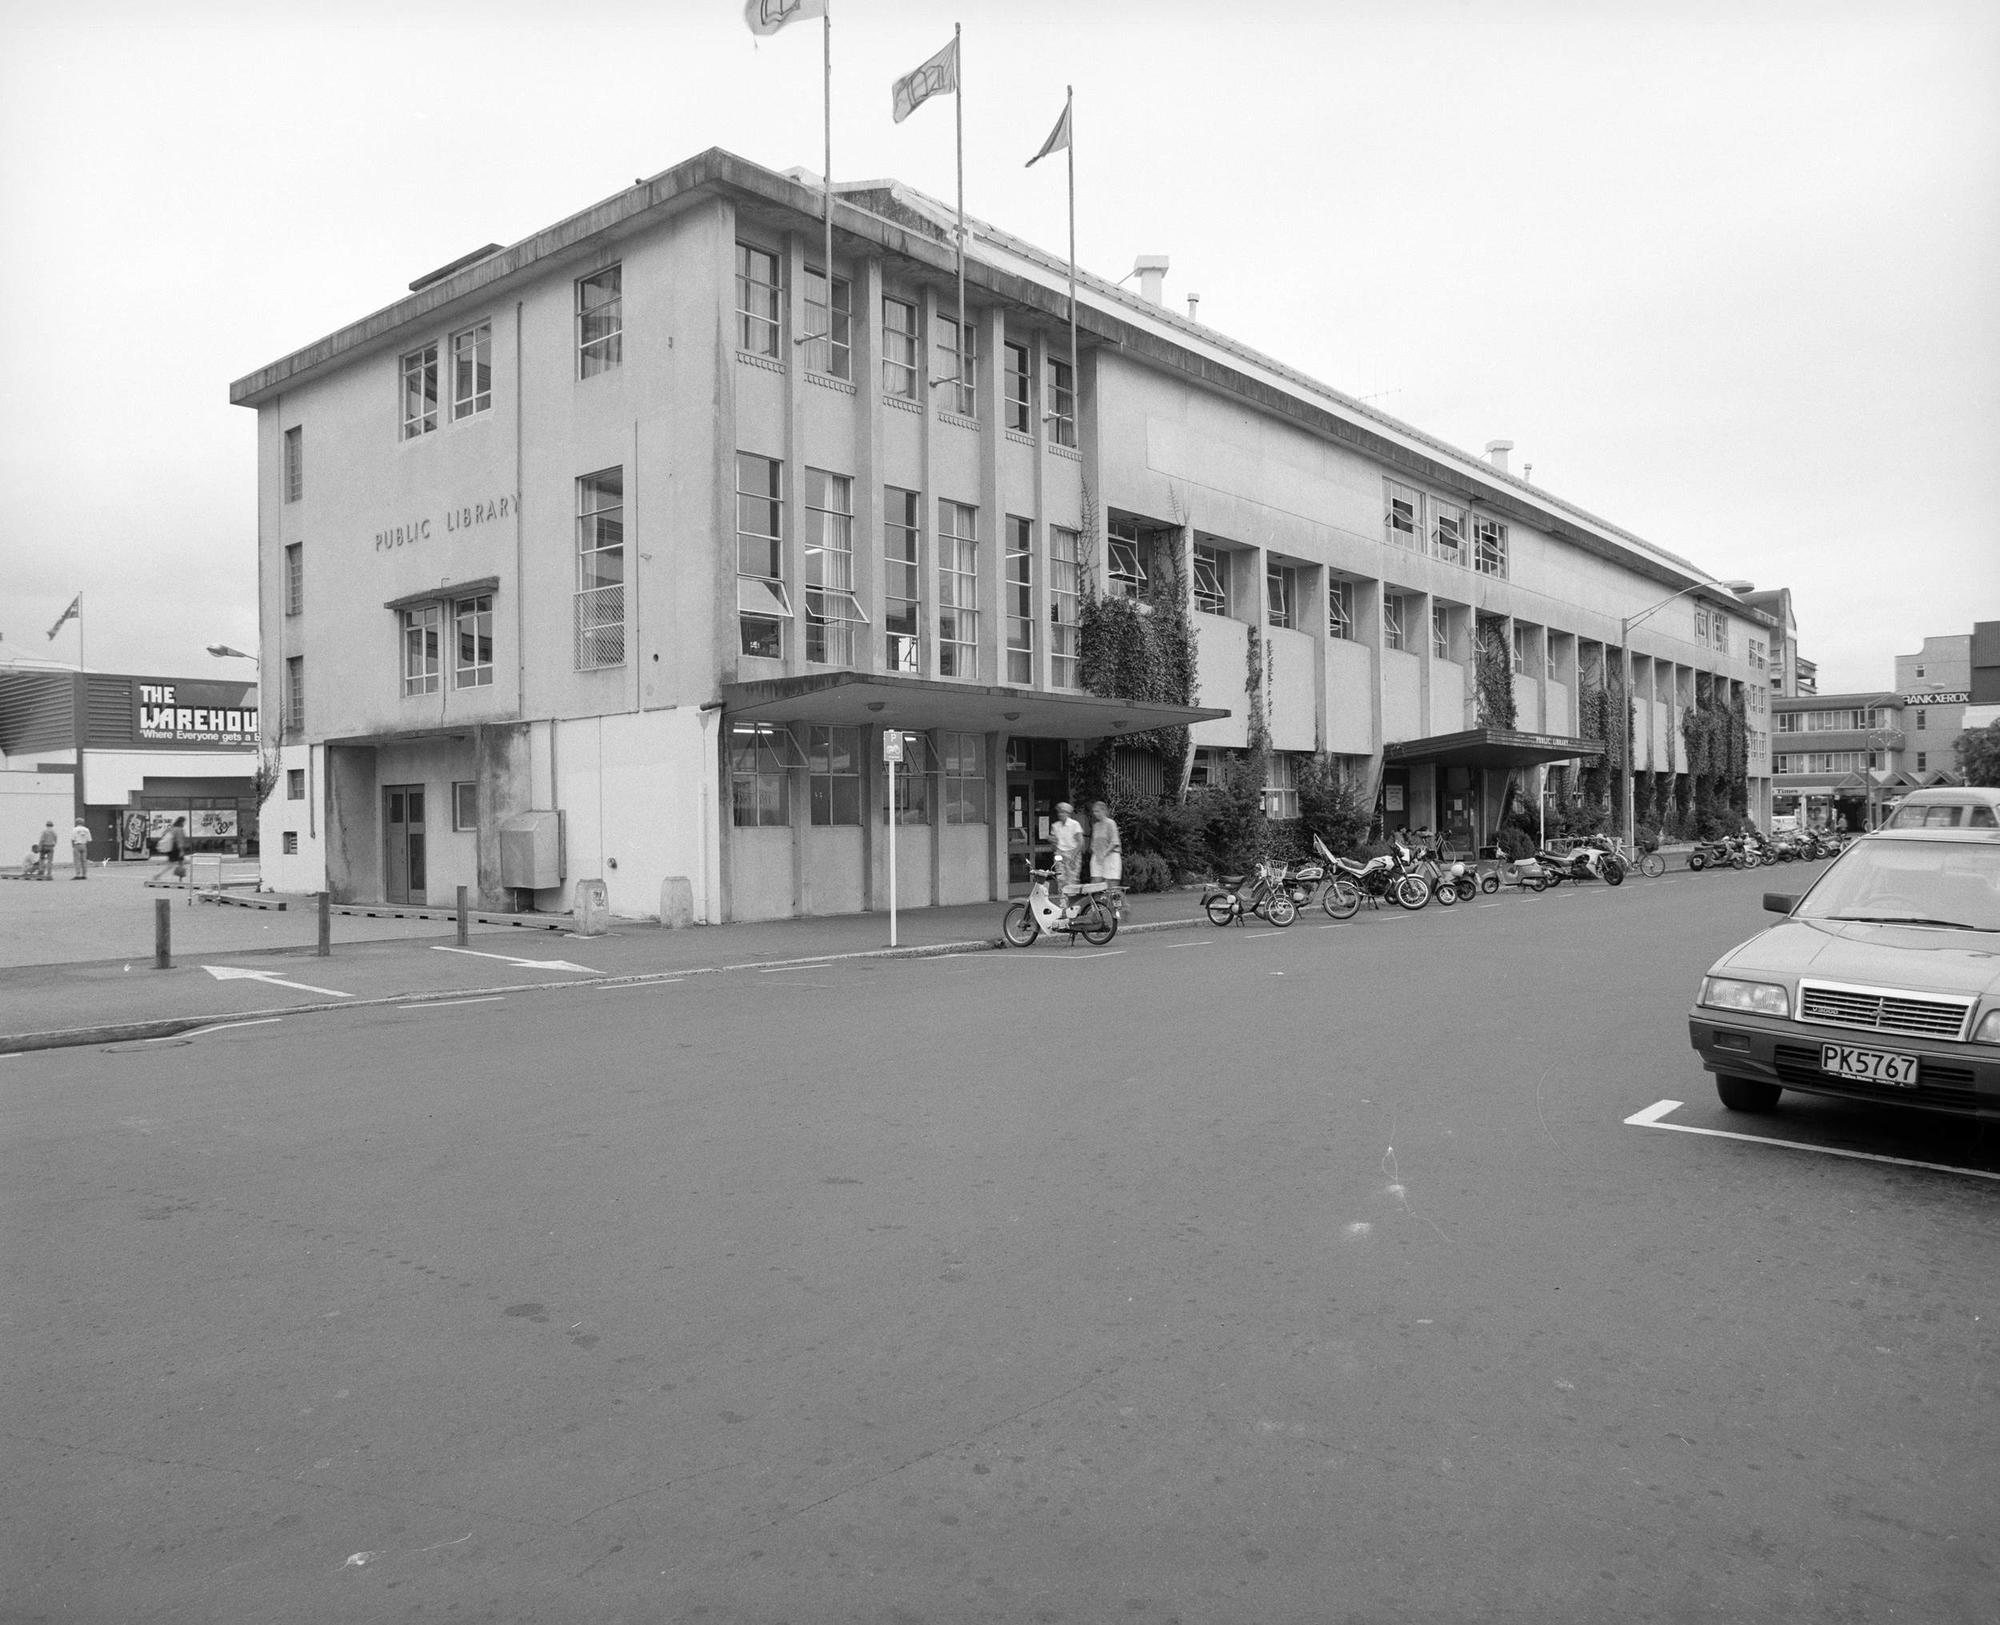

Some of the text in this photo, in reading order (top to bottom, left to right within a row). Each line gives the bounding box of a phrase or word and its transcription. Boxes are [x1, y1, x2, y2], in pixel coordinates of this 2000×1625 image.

[376, 494, 519, 551] PUBLIC LIBRARY
[140, 685, 175, 703] THE
[1934, 692, 1969, 703] XEROX
[140, 707, 258, 732] WAREHOU
[176, 730, 219, 741] Everyone
[222, 732, 241, 742] gets
[890, 733, 897, 742] P
[1823, 1046, 1915, 1081] PK5767
